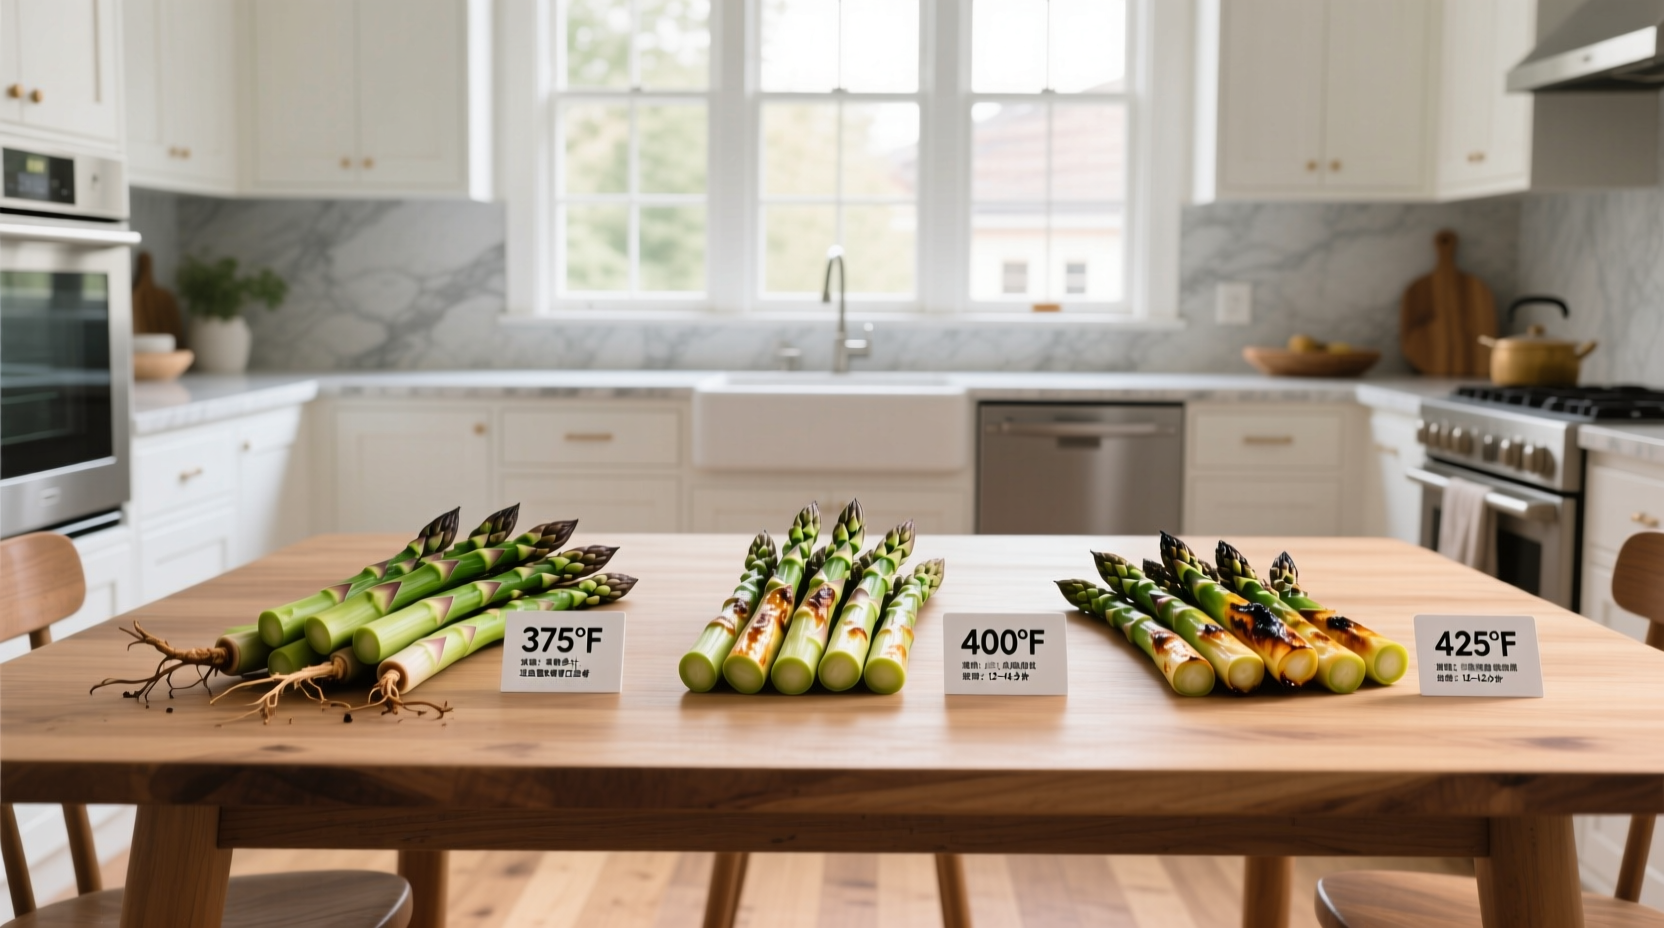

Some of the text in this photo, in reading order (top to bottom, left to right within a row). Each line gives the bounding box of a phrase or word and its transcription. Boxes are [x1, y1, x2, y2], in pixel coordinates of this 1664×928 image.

[521, 626, 603, 653] 375°F
[961, 628, 1045, 655] 400°F
[1435, 630, 1516, 657] 425°F
